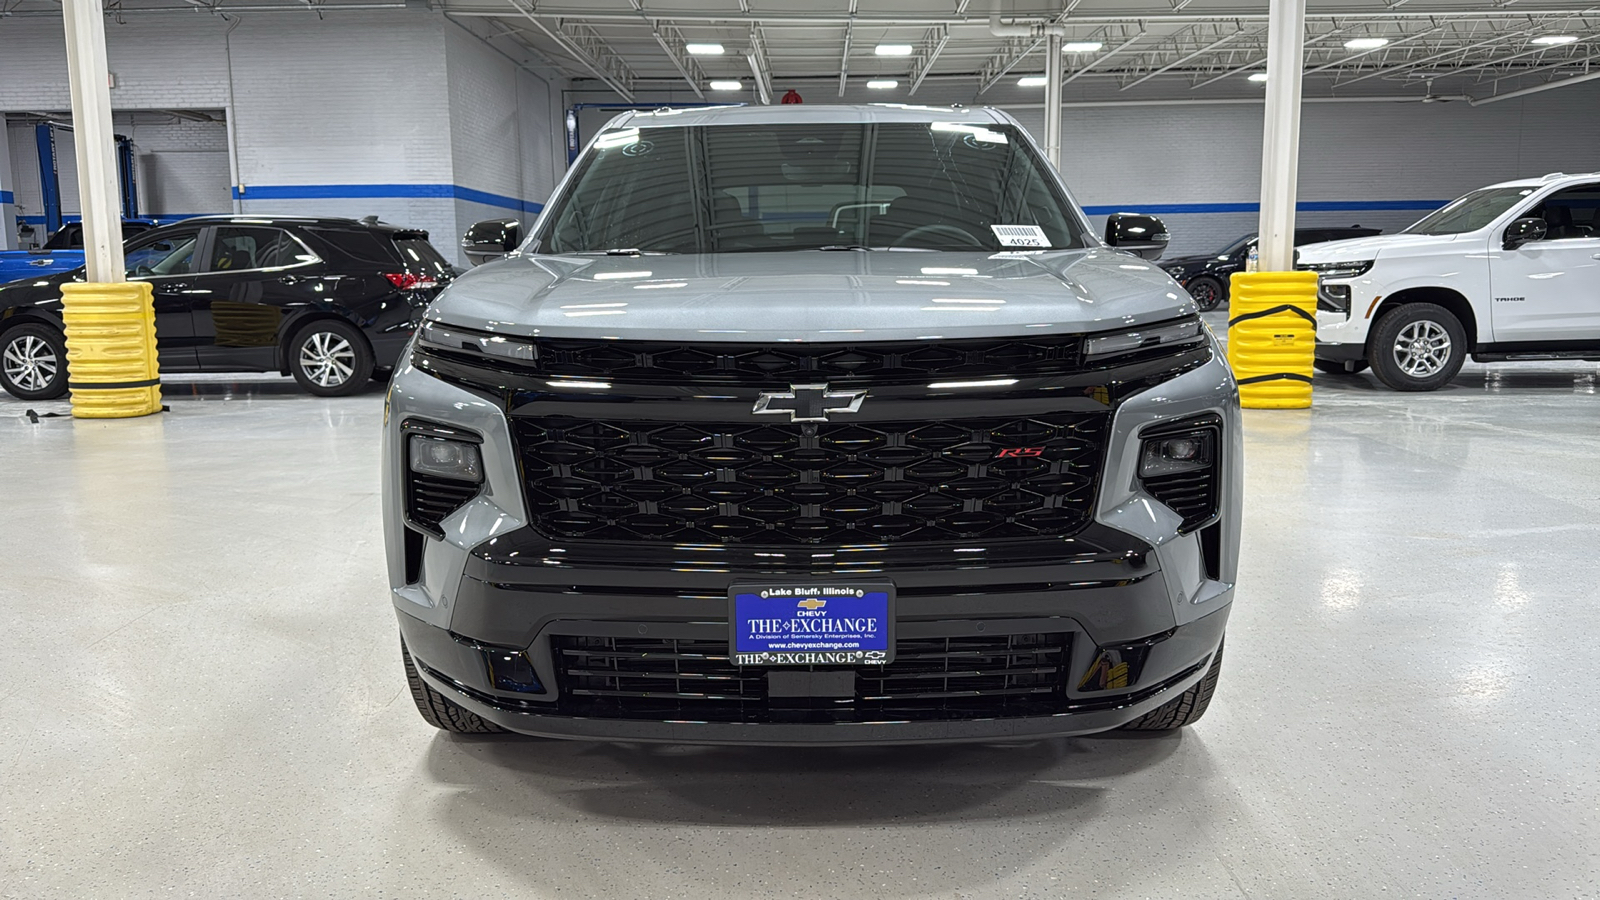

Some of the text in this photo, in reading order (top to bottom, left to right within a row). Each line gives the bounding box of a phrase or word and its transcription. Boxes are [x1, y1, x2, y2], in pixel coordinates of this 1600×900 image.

[997, 447, 1045, 458] RS
[769, 588, 792, 596] Lake
[823, 587, 854, 595] Illinois
[747, 617, 877, 633] THE EXCHANGE
[768, 641, 860, 650] www.chevyexchange.com
[735, 652, 856, 665] THE EXCHANGE
